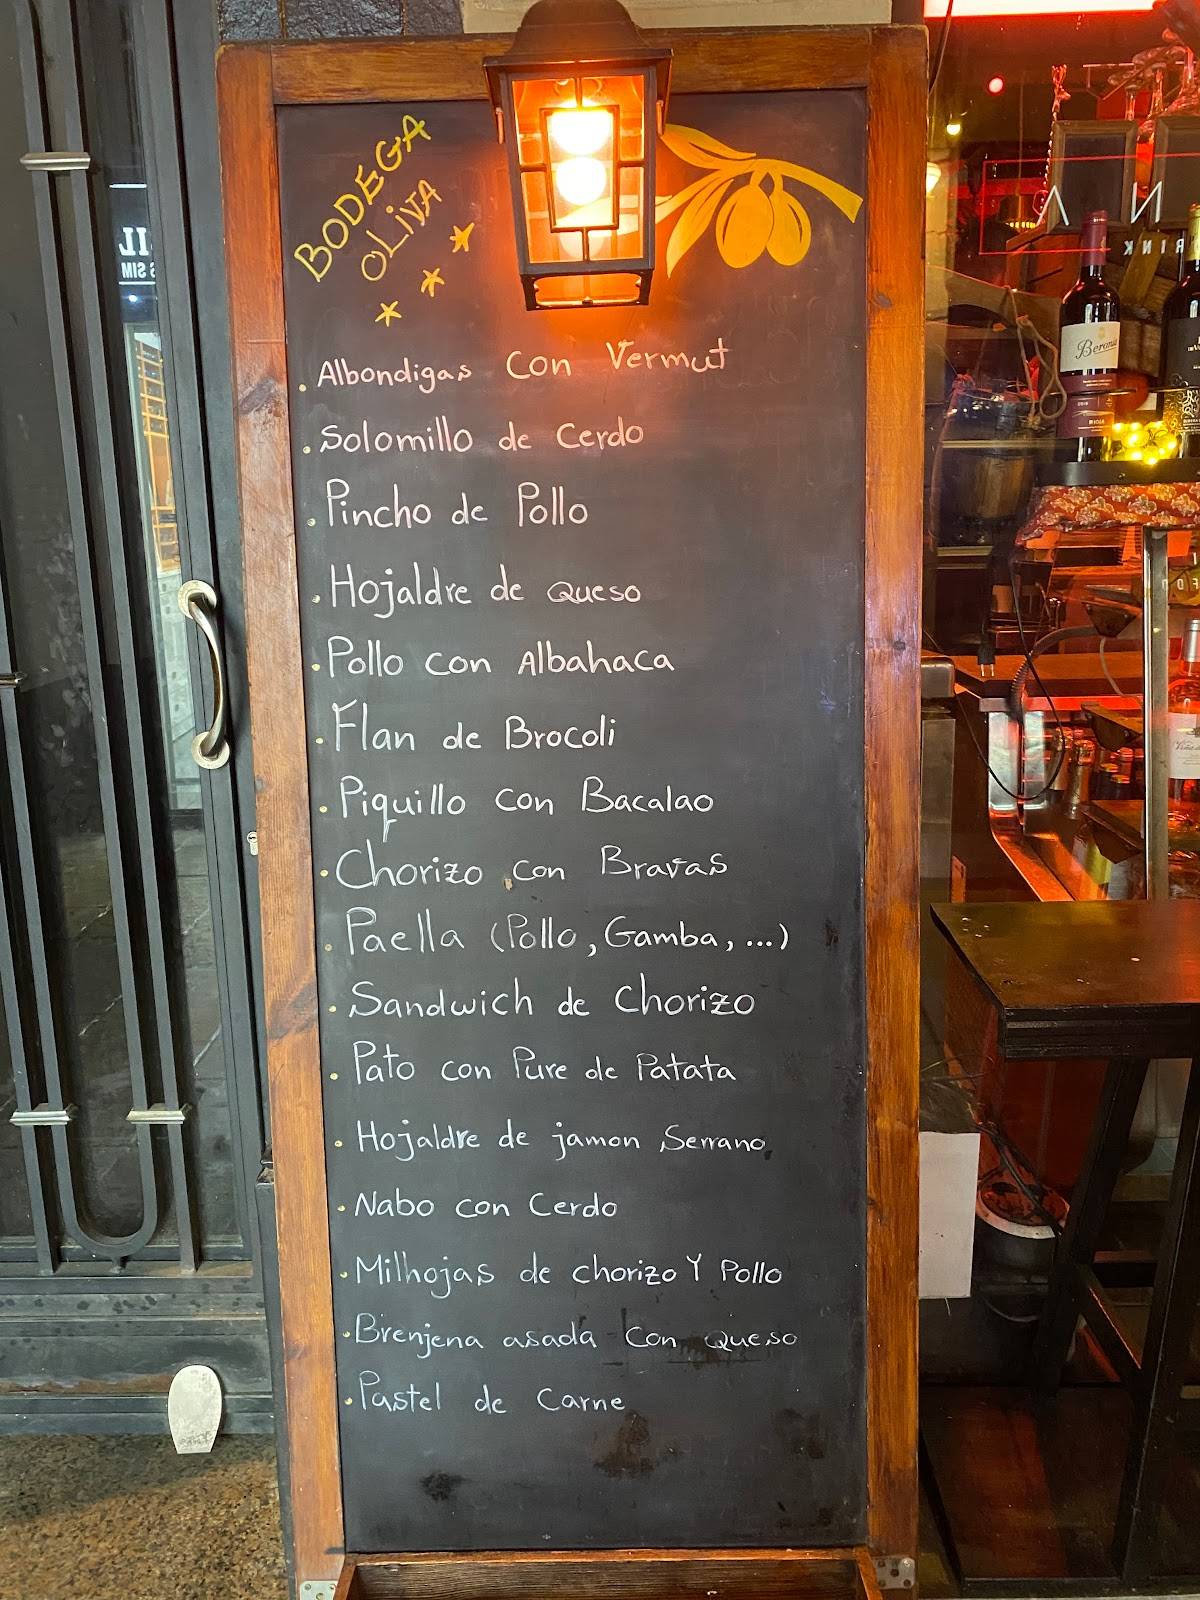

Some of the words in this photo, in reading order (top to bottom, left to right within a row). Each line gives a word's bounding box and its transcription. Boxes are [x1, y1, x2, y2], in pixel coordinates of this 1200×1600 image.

[294, 114, 431, 282] BODEGA
[317, 357, 473, 394] Albondigas
[606, 337, 729, 373] Vermut
[319, 415, 473, 453] Solomillo
[498, 420, 533, 452] de
[556, 416, 644, 451] Cerdo
[326, 477, 432, 528] Pincho
[451, 492, 489, 525] de
[517, 481, 588, 528] Pollo
[330, 561, 473, 619] Hojaldre
[490, 563, 525, 602] de
[546, 580, 642, 604] Queso
[327, 635, 404, 678] Pollo
[517, 640, 675, 677] Albahaca
[331, 698, 415, 752] Flan
[442, 721, 482, 750] de
[505, 714, 617, 751] Brocoli
[339, 775, 466, 843] Piquillo
[581, 775, 714, 813] Bacalao
[335, 838, 483, 890] Chorizo
[600, 844, 728, 881] Bravas
[345, 906, 465, 956] Paella
[348, 976, 533, 1018] Sandwich
[557, 985, 591, 1017] de
[352, 1040, 415, 1085] Pato
[512, 1045, 568, 1081] Pure
[584, 1055, 619, 1082] de
[635, 1052, 737, 1082] Patata
[356, 1119, 481, 1162] Hojaldre
[498, 1118, 530, 1149] de
[551, 1121, 641, 1162] jamon
[659, 1124, 766, 1153] Serrano
[354, 1187, 435, 1217] Nabo
[528, 1191, 618, 1218] Cerdo
[356, 1250, 495, 1300] Milhojas
[519, 1250, 551, 1285] de
[720, 1258, 783, 1285] Pollo
[355, 1312, 485, 1360] Brenjena
[502, 1320, 598, 1349] asada
[704, 1328, 798, 1353] Queso
[359, 1370, 441, 1413] Pastel
[474, 1383, 507, 1415] de
